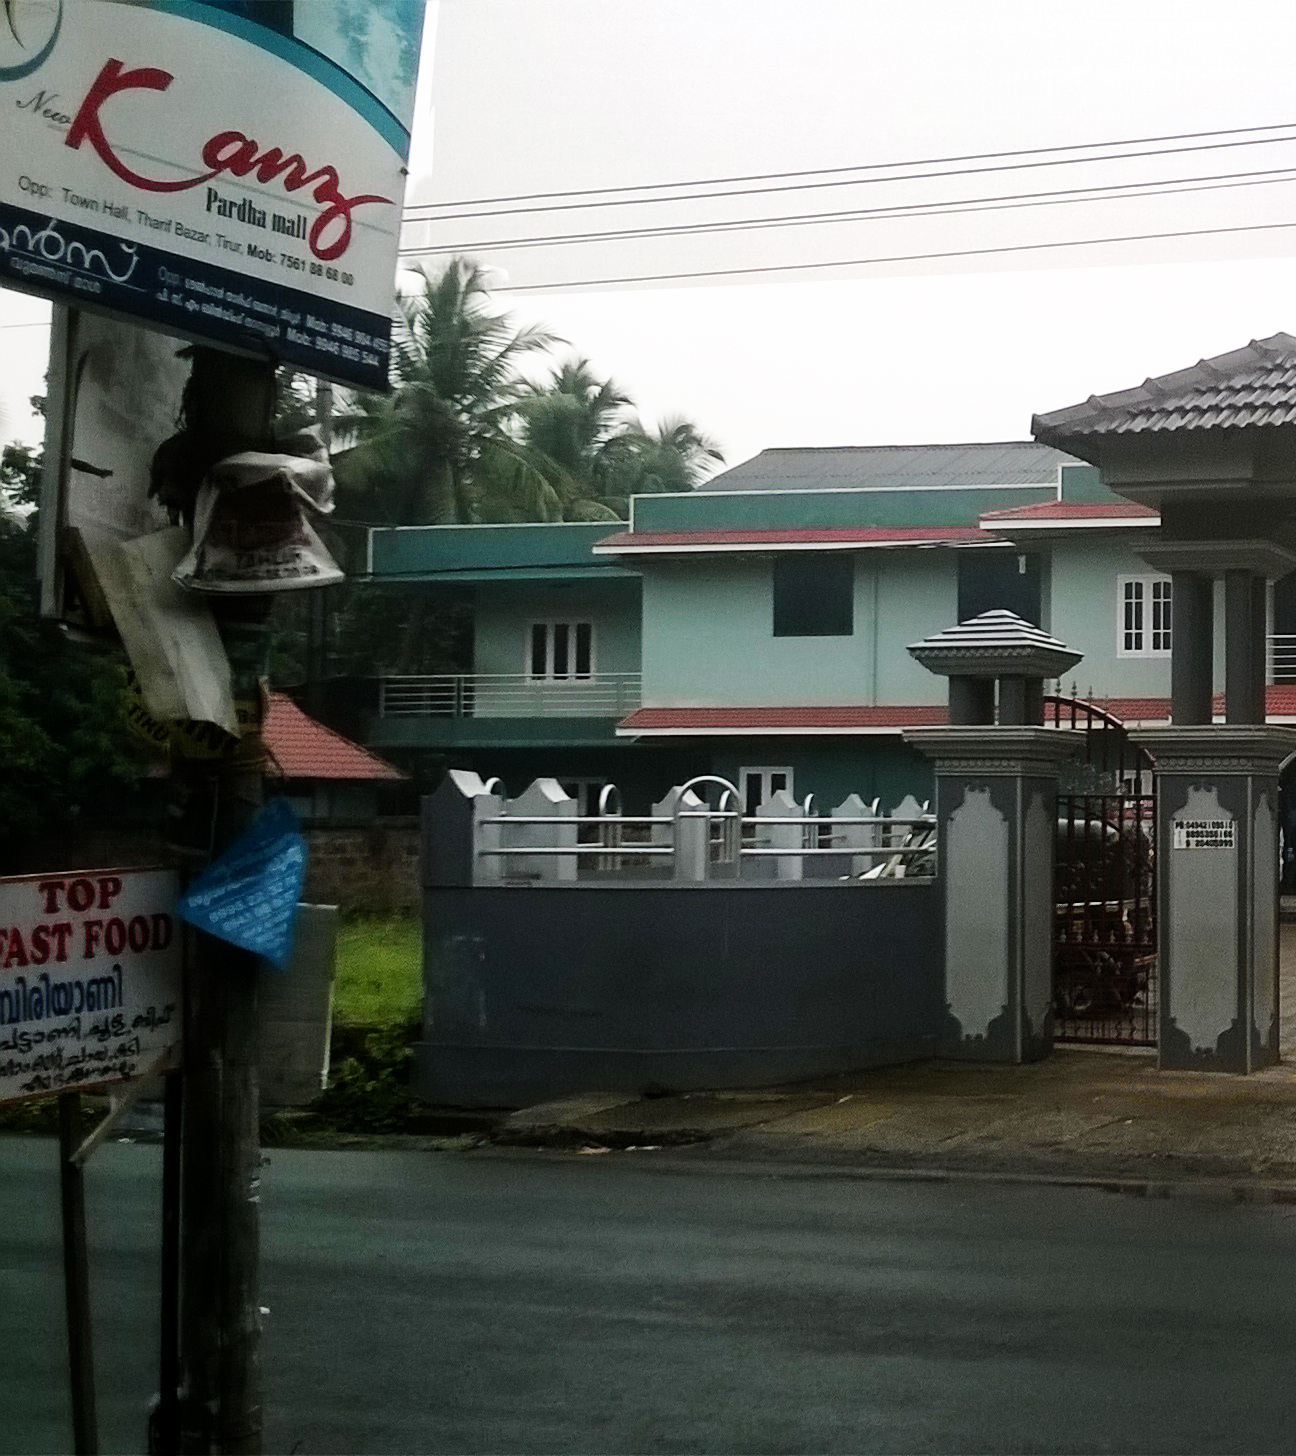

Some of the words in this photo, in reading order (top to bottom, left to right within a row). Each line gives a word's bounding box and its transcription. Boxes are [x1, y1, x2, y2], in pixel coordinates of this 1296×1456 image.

[15, 89, 72, 125] New
[62, 187, 100, 211] Town
[246, 243, 277, 264] Mob:
[280, 253, 306, 273] 7561
[206, 187, 267, 229] Pardha
[272, 212, 308, 241] mall
[38, 876, 123, 914] TOP
[83, 913, 174, 959] FOOD
